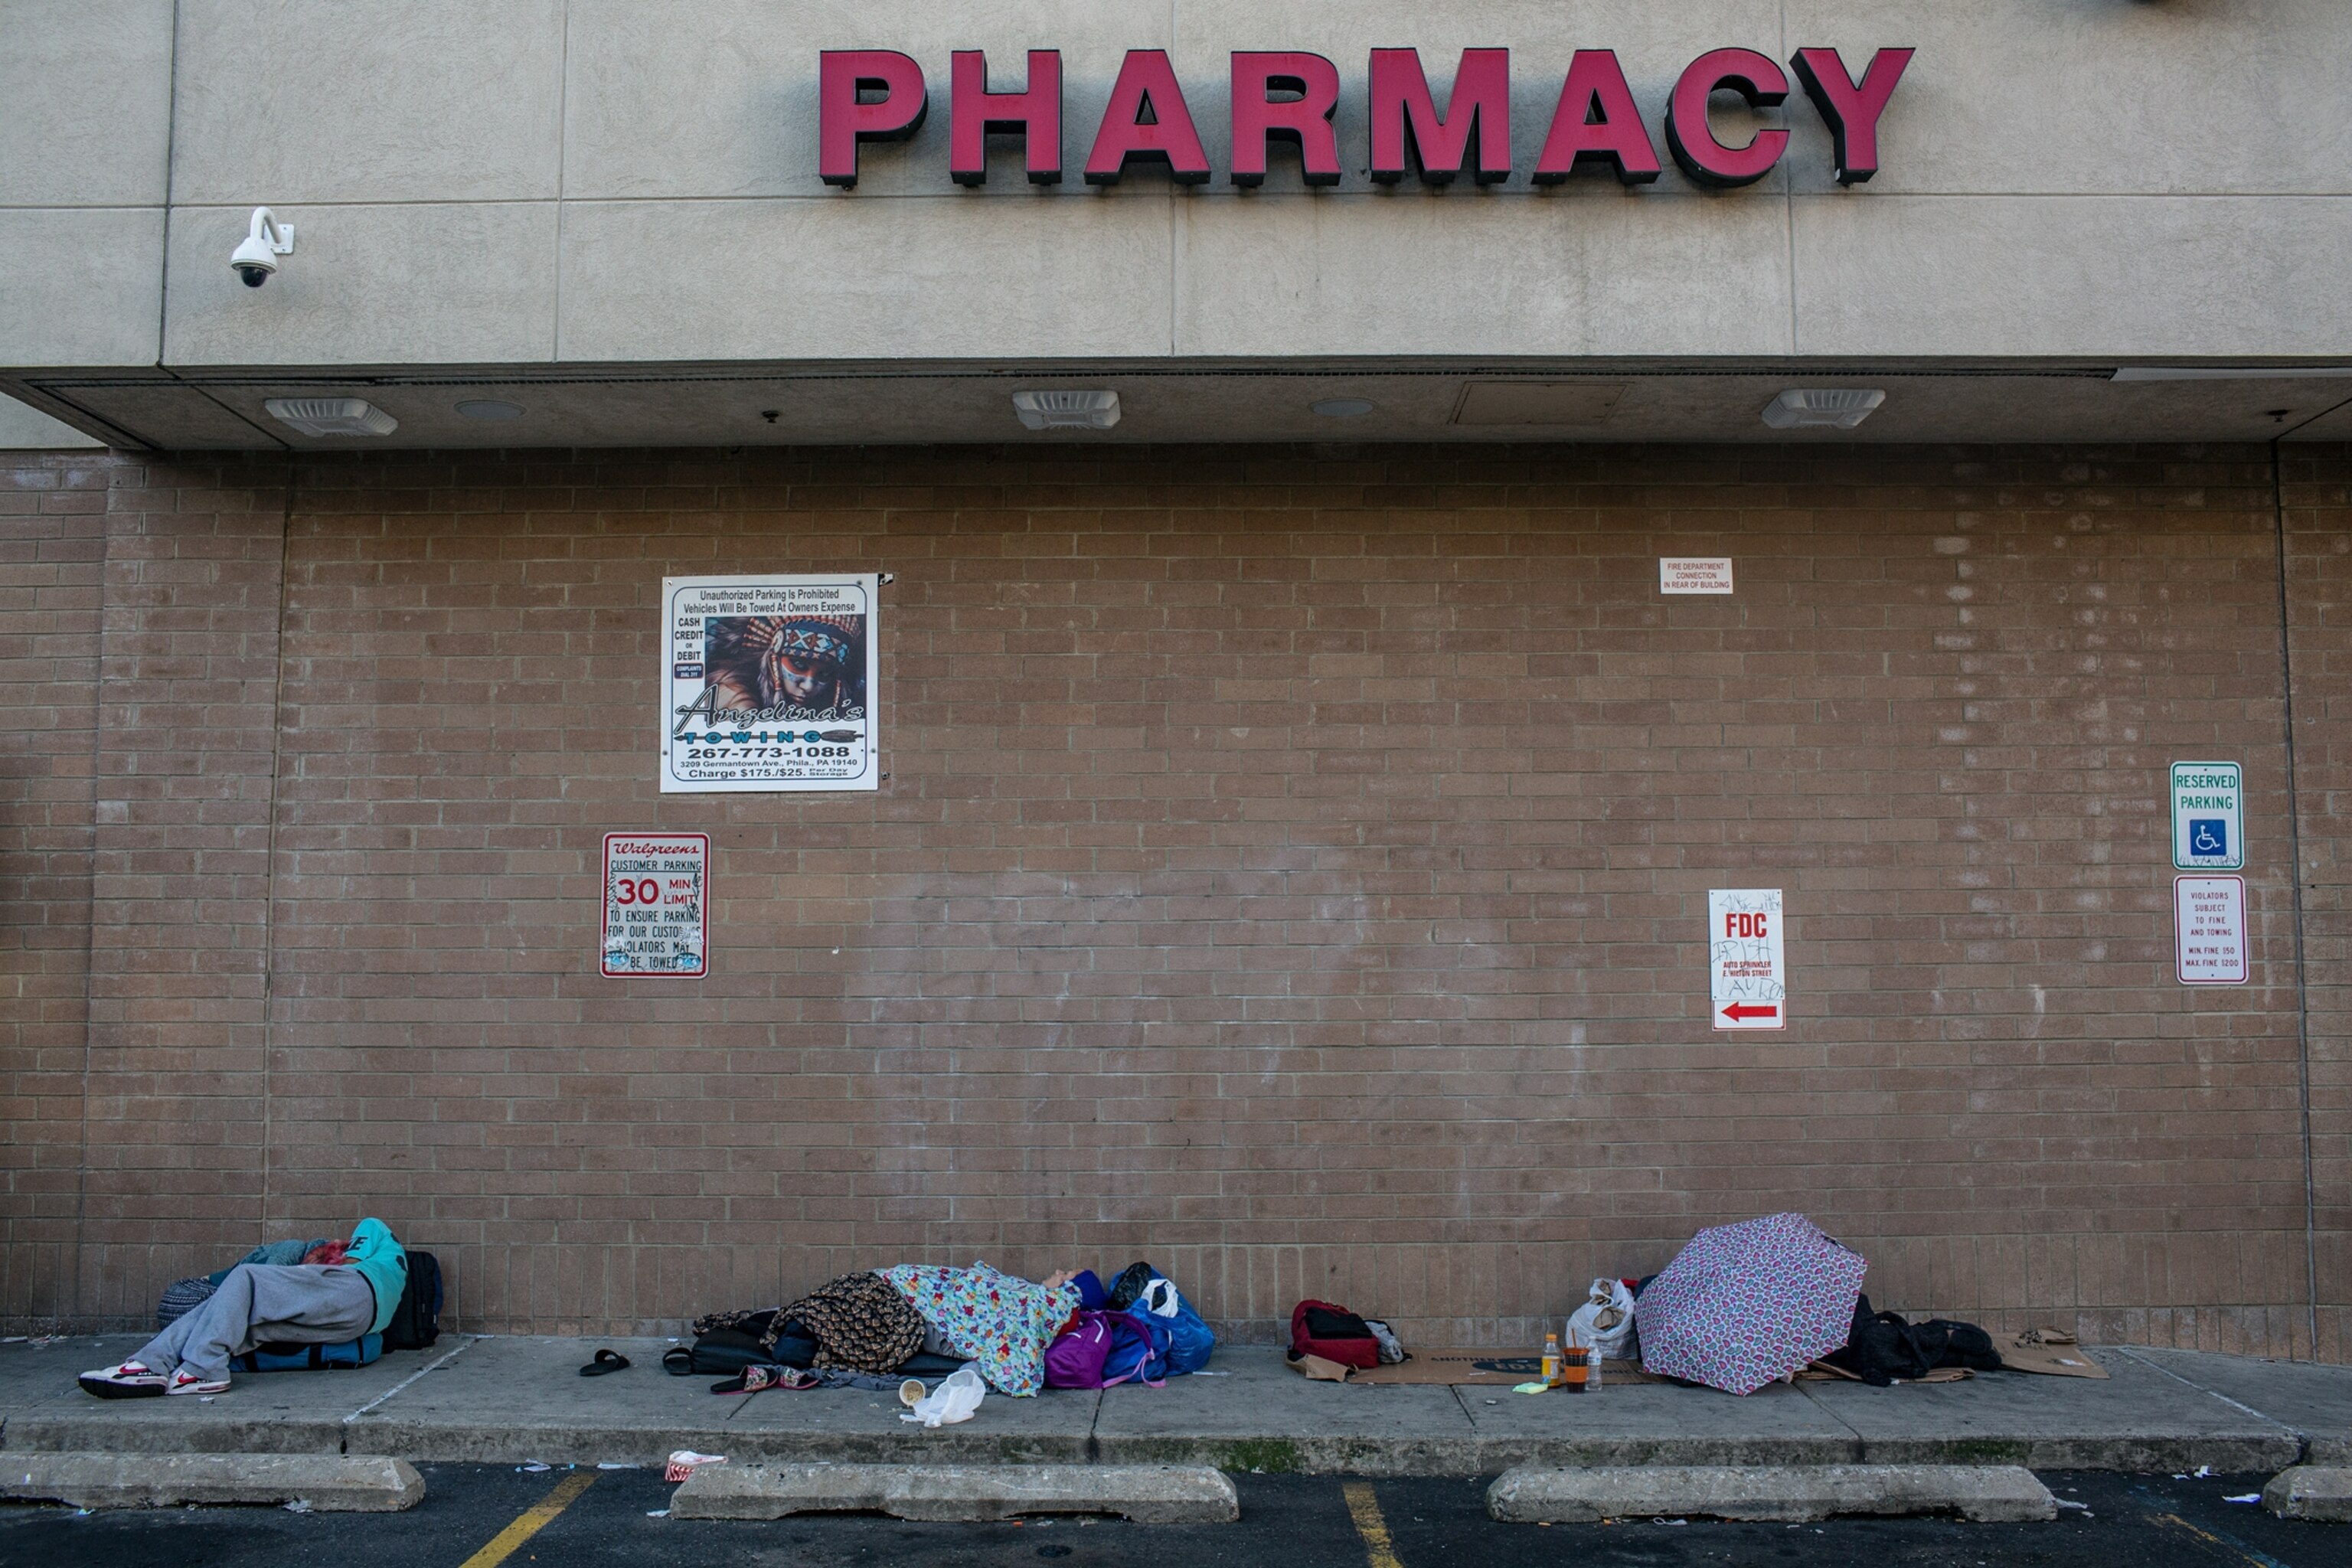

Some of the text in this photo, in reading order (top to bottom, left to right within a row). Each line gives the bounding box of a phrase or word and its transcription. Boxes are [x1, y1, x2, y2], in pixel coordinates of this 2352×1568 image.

[819, 47, 1916, 186] PHARMACY
[700, 589, 839, 602] Unauthorized Parking Is Prohibited
[684, 602, 855, 613] Vehicles Will Be Towed At Owners Expense
[678, 618, 700, 626] CASH
[675, 631, 704, 640] CREDIT
[678, 652, 701, 660] DEBIT
[674, 683, 864, 735] Angelina's
[683, 730, 822, 744] TOWING
[688, 746, 850, 760] 267-773-1088
[688, 769, 736, 779] Charge
[2176, 775, 2236, 789] RESERVED
[2180, 795, 2233, 809] PARKING
[613, 842, 699, 858] Walgreens
[611, 860, 701, 871] CUSTOMER PARKING
[669, 879, 691, 889] MIN
[616, 878, 658, 905] 30
[664, 894, 694, 904] LIMIT
[610, 910, 700, 923] TO ENSURE PARKING
[608, 926, 624, 937] FOR
[629, 926, 647, 937] OUR
[1726, 913, 1767, 937] FDC
[630, 956, 678, 969] BE TOWED
